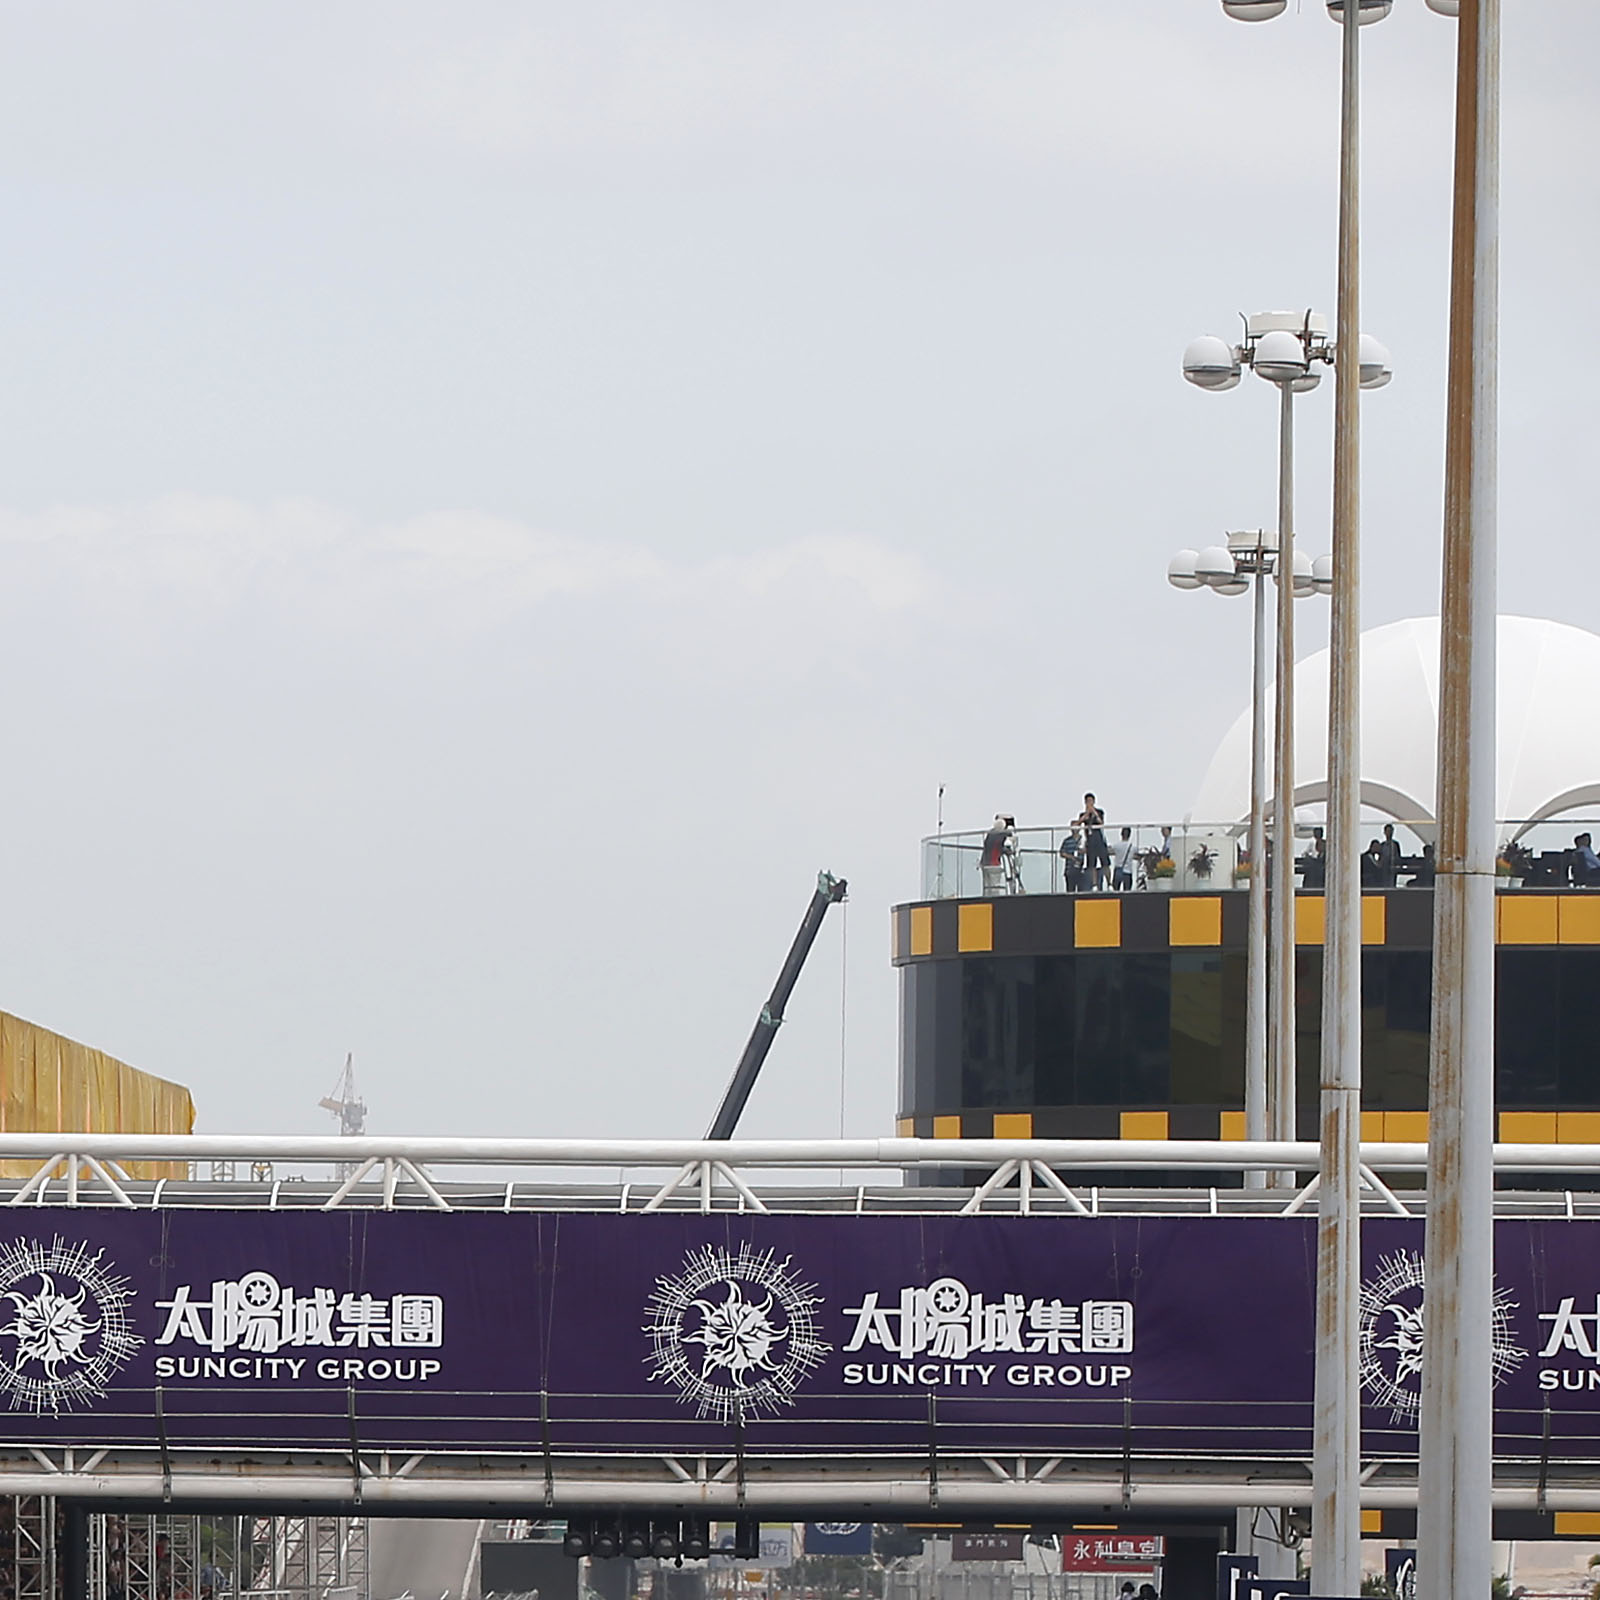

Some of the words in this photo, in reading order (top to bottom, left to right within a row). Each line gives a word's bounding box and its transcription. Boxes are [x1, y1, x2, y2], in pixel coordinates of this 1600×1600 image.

[155, 1272, 442, 1352] 太陽城集團
[843, 1278, 1133, 1357] 太陽城集團
[156, 1357, 306, 1378] SUNCITY
[318, 1359, 440, 1380] GROUP
[844, 1364, 995, 1384] SUNCITY
[1008, 1366, 1131, 1385] GROUP
